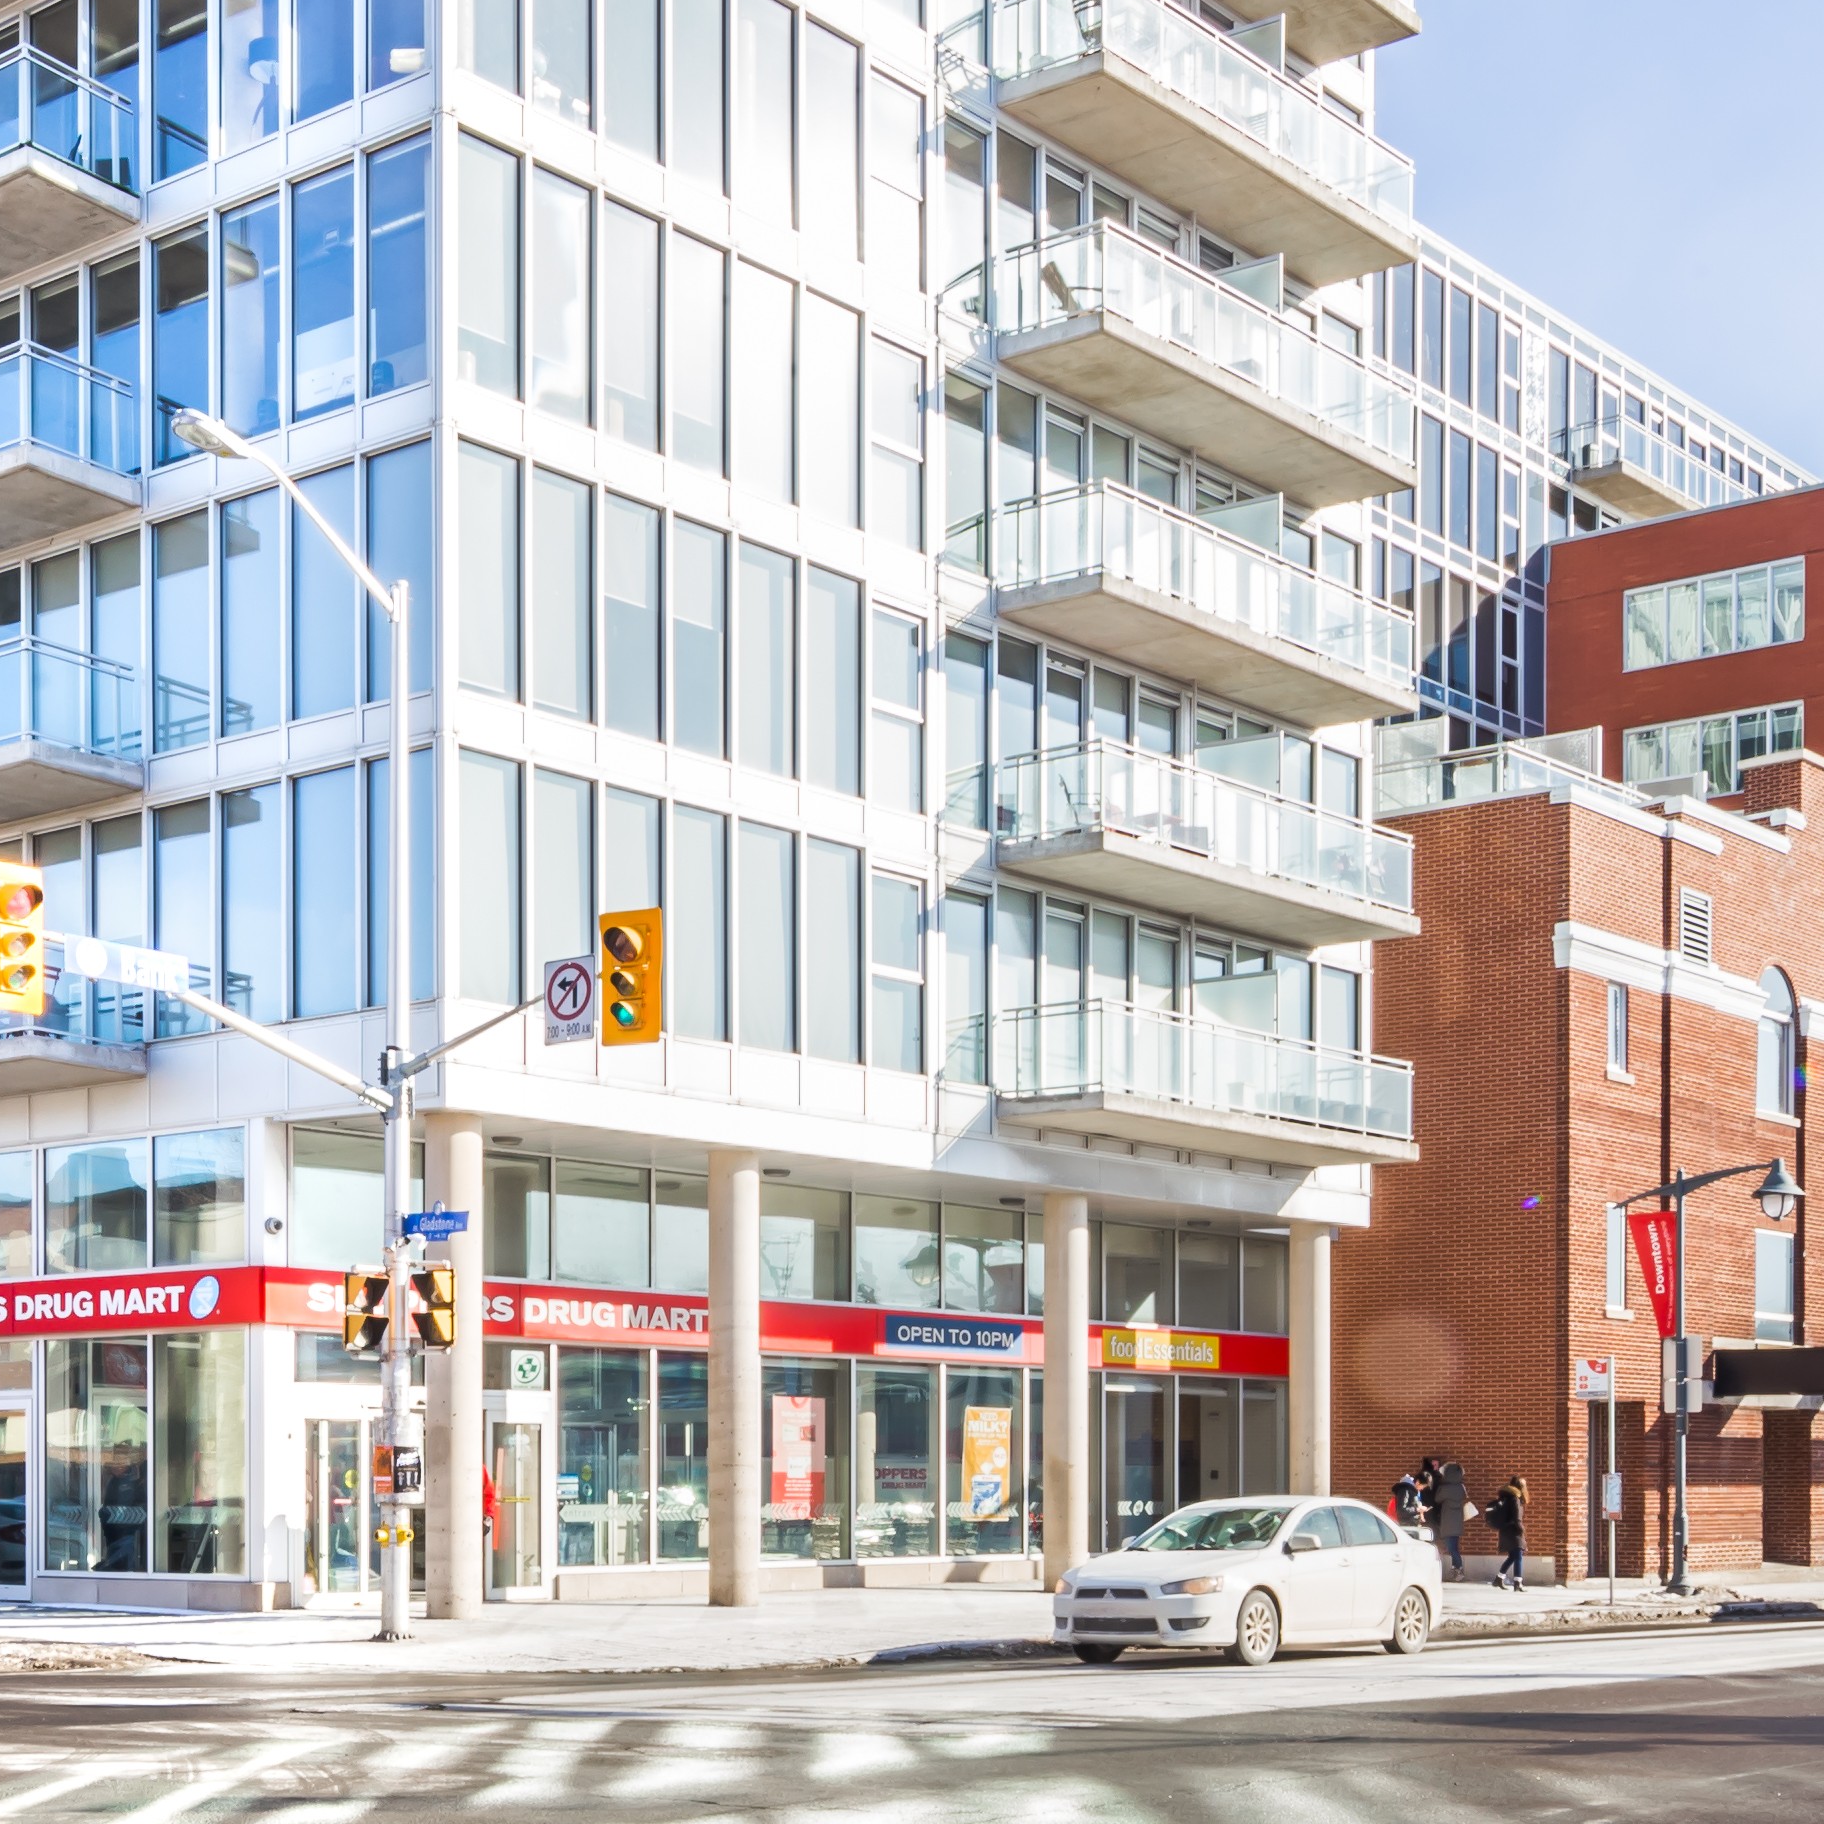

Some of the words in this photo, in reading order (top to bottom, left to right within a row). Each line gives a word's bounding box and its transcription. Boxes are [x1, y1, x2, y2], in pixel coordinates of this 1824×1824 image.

[1647, 1221, 1665, 1294] Downtown.
[14, 1291, 94, 1321] DRUG
[100, 1285, 185, 1316] MART
[524, 1297, 616, 1328] DRUG
[622, 1303, 709, 1332] MART
[897, 1325, 945, 1344] OPEN
[949, 1328, 971, 1345] TO
[976, 1330, 1015, 1349] 10PM
[1110, 1336, 1213, 1363] foodEssentials
